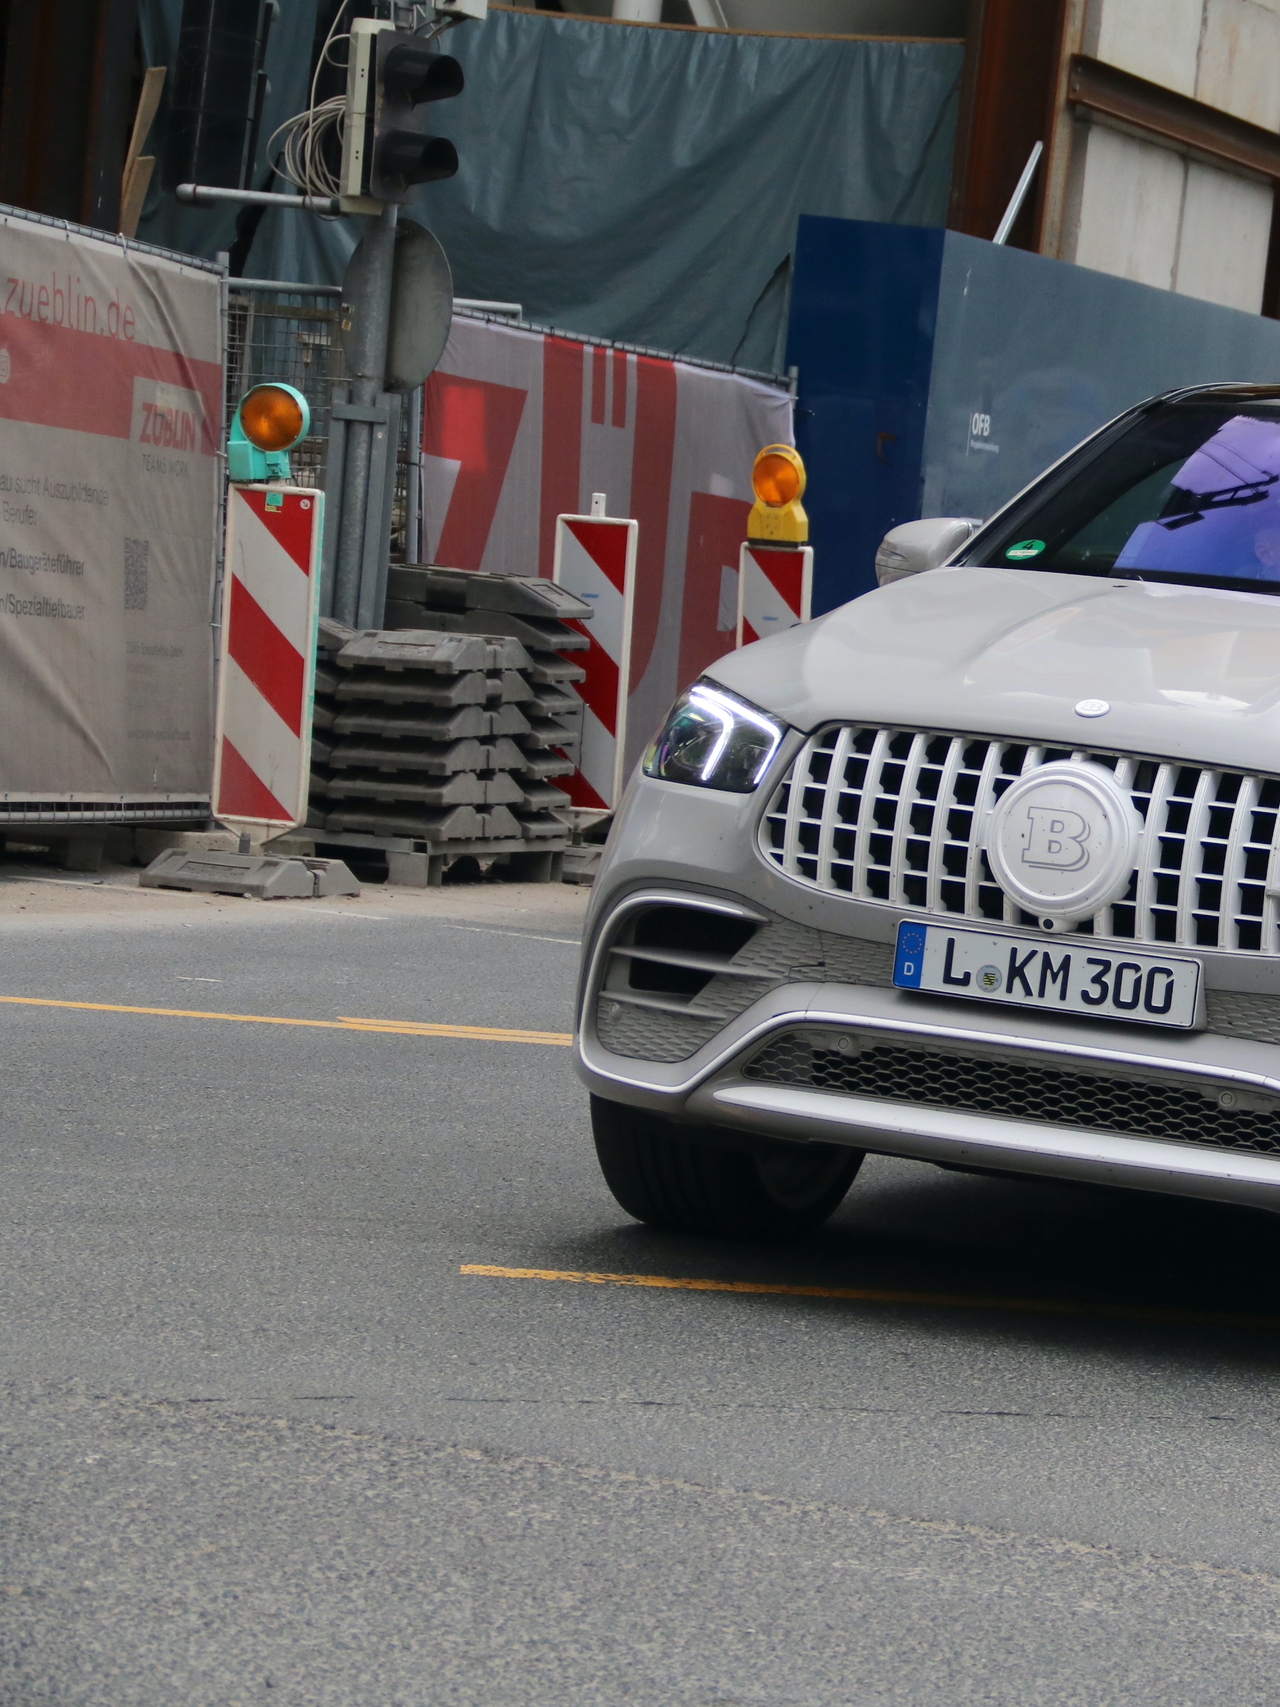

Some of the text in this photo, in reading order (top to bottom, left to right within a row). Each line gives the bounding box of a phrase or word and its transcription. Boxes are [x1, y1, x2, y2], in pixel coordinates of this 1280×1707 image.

[971, 412, 991, 437] OFB
[14, 475, 41, 496] sucht
[1021, 540, 1036, 551] 4
[1021, 805, 1092, 873] B
[903, 961, 916, 977] D
[942, 936, 1175, 1015] L KM 300
